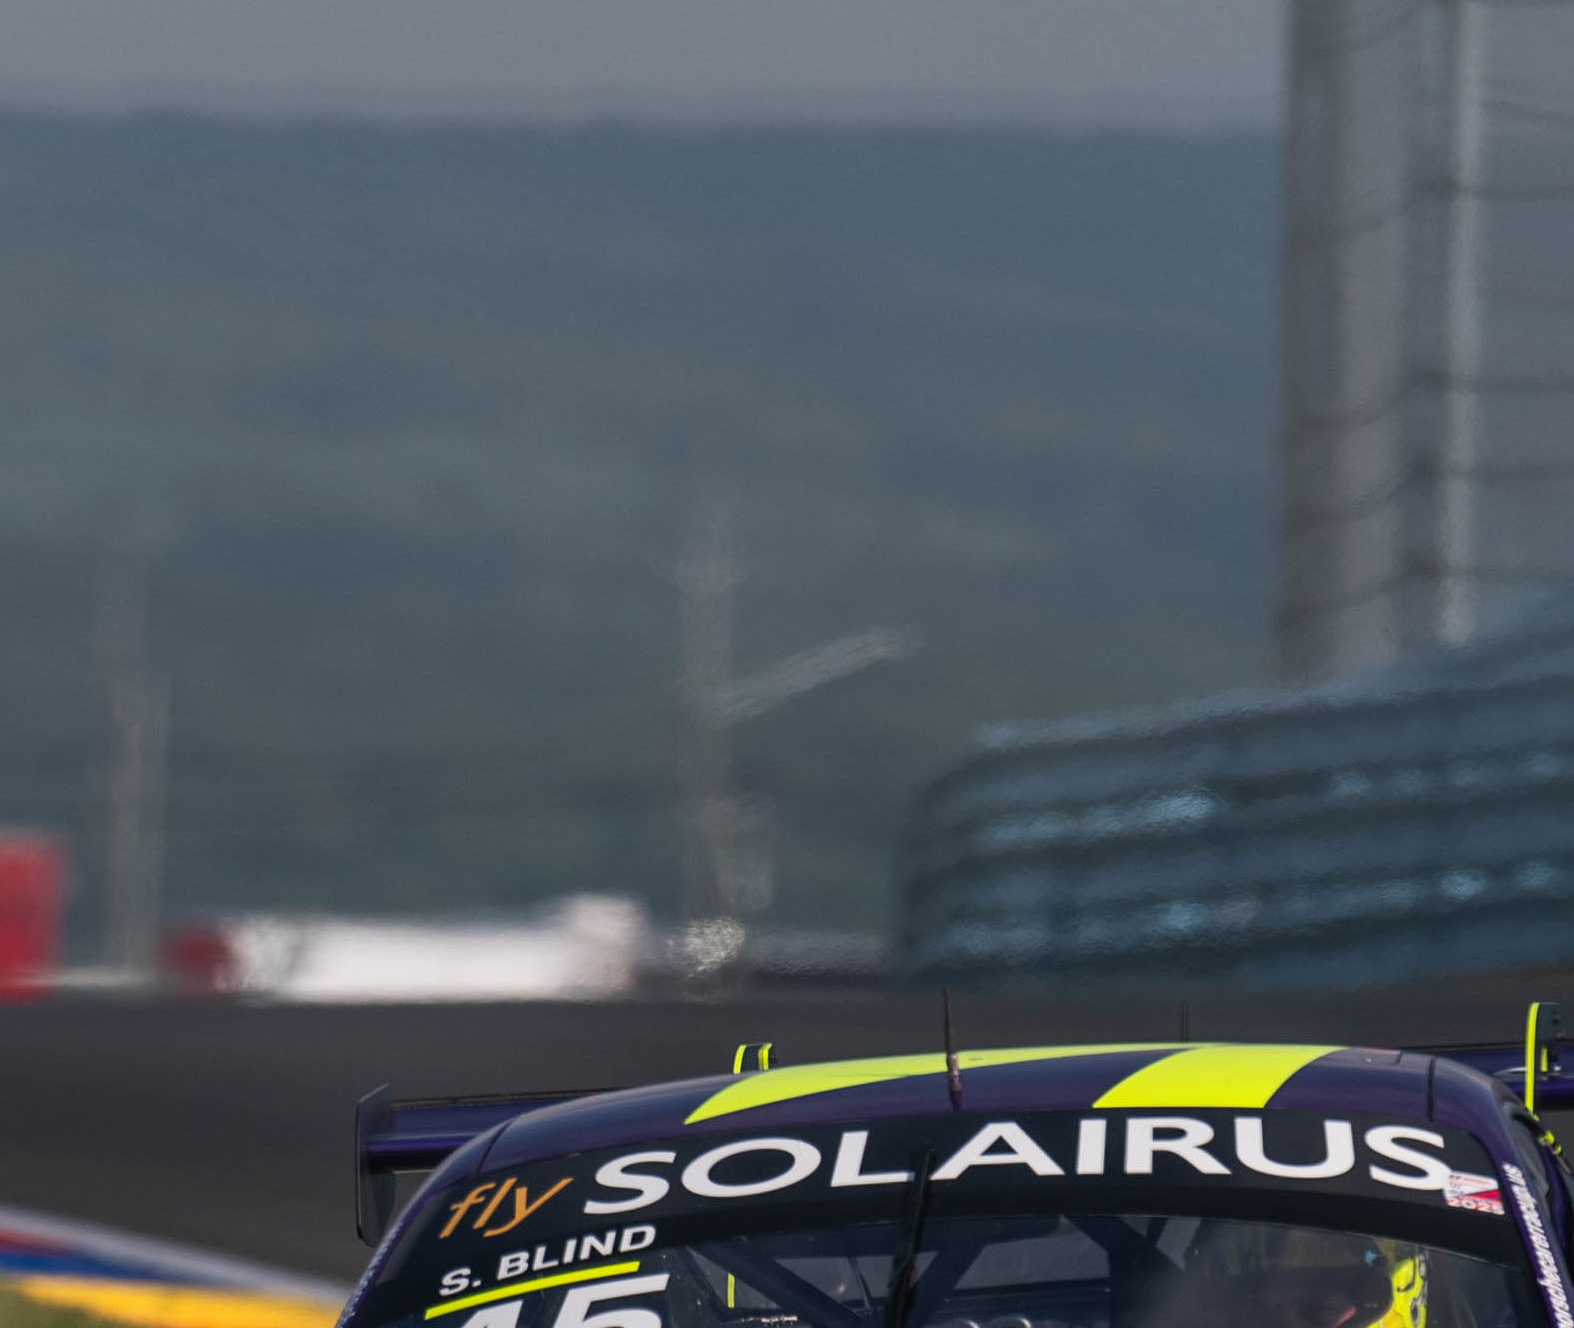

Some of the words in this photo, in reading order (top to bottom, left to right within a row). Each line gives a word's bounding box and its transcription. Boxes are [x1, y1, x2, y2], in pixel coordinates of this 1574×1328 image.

[439, 1176, 574, 1239] fly
[583, 1117, 1453, 1214] SOLAIRUS
[439, 1268, 481, 1297] S.
[497, 1225, 656, 1281] BLIND
